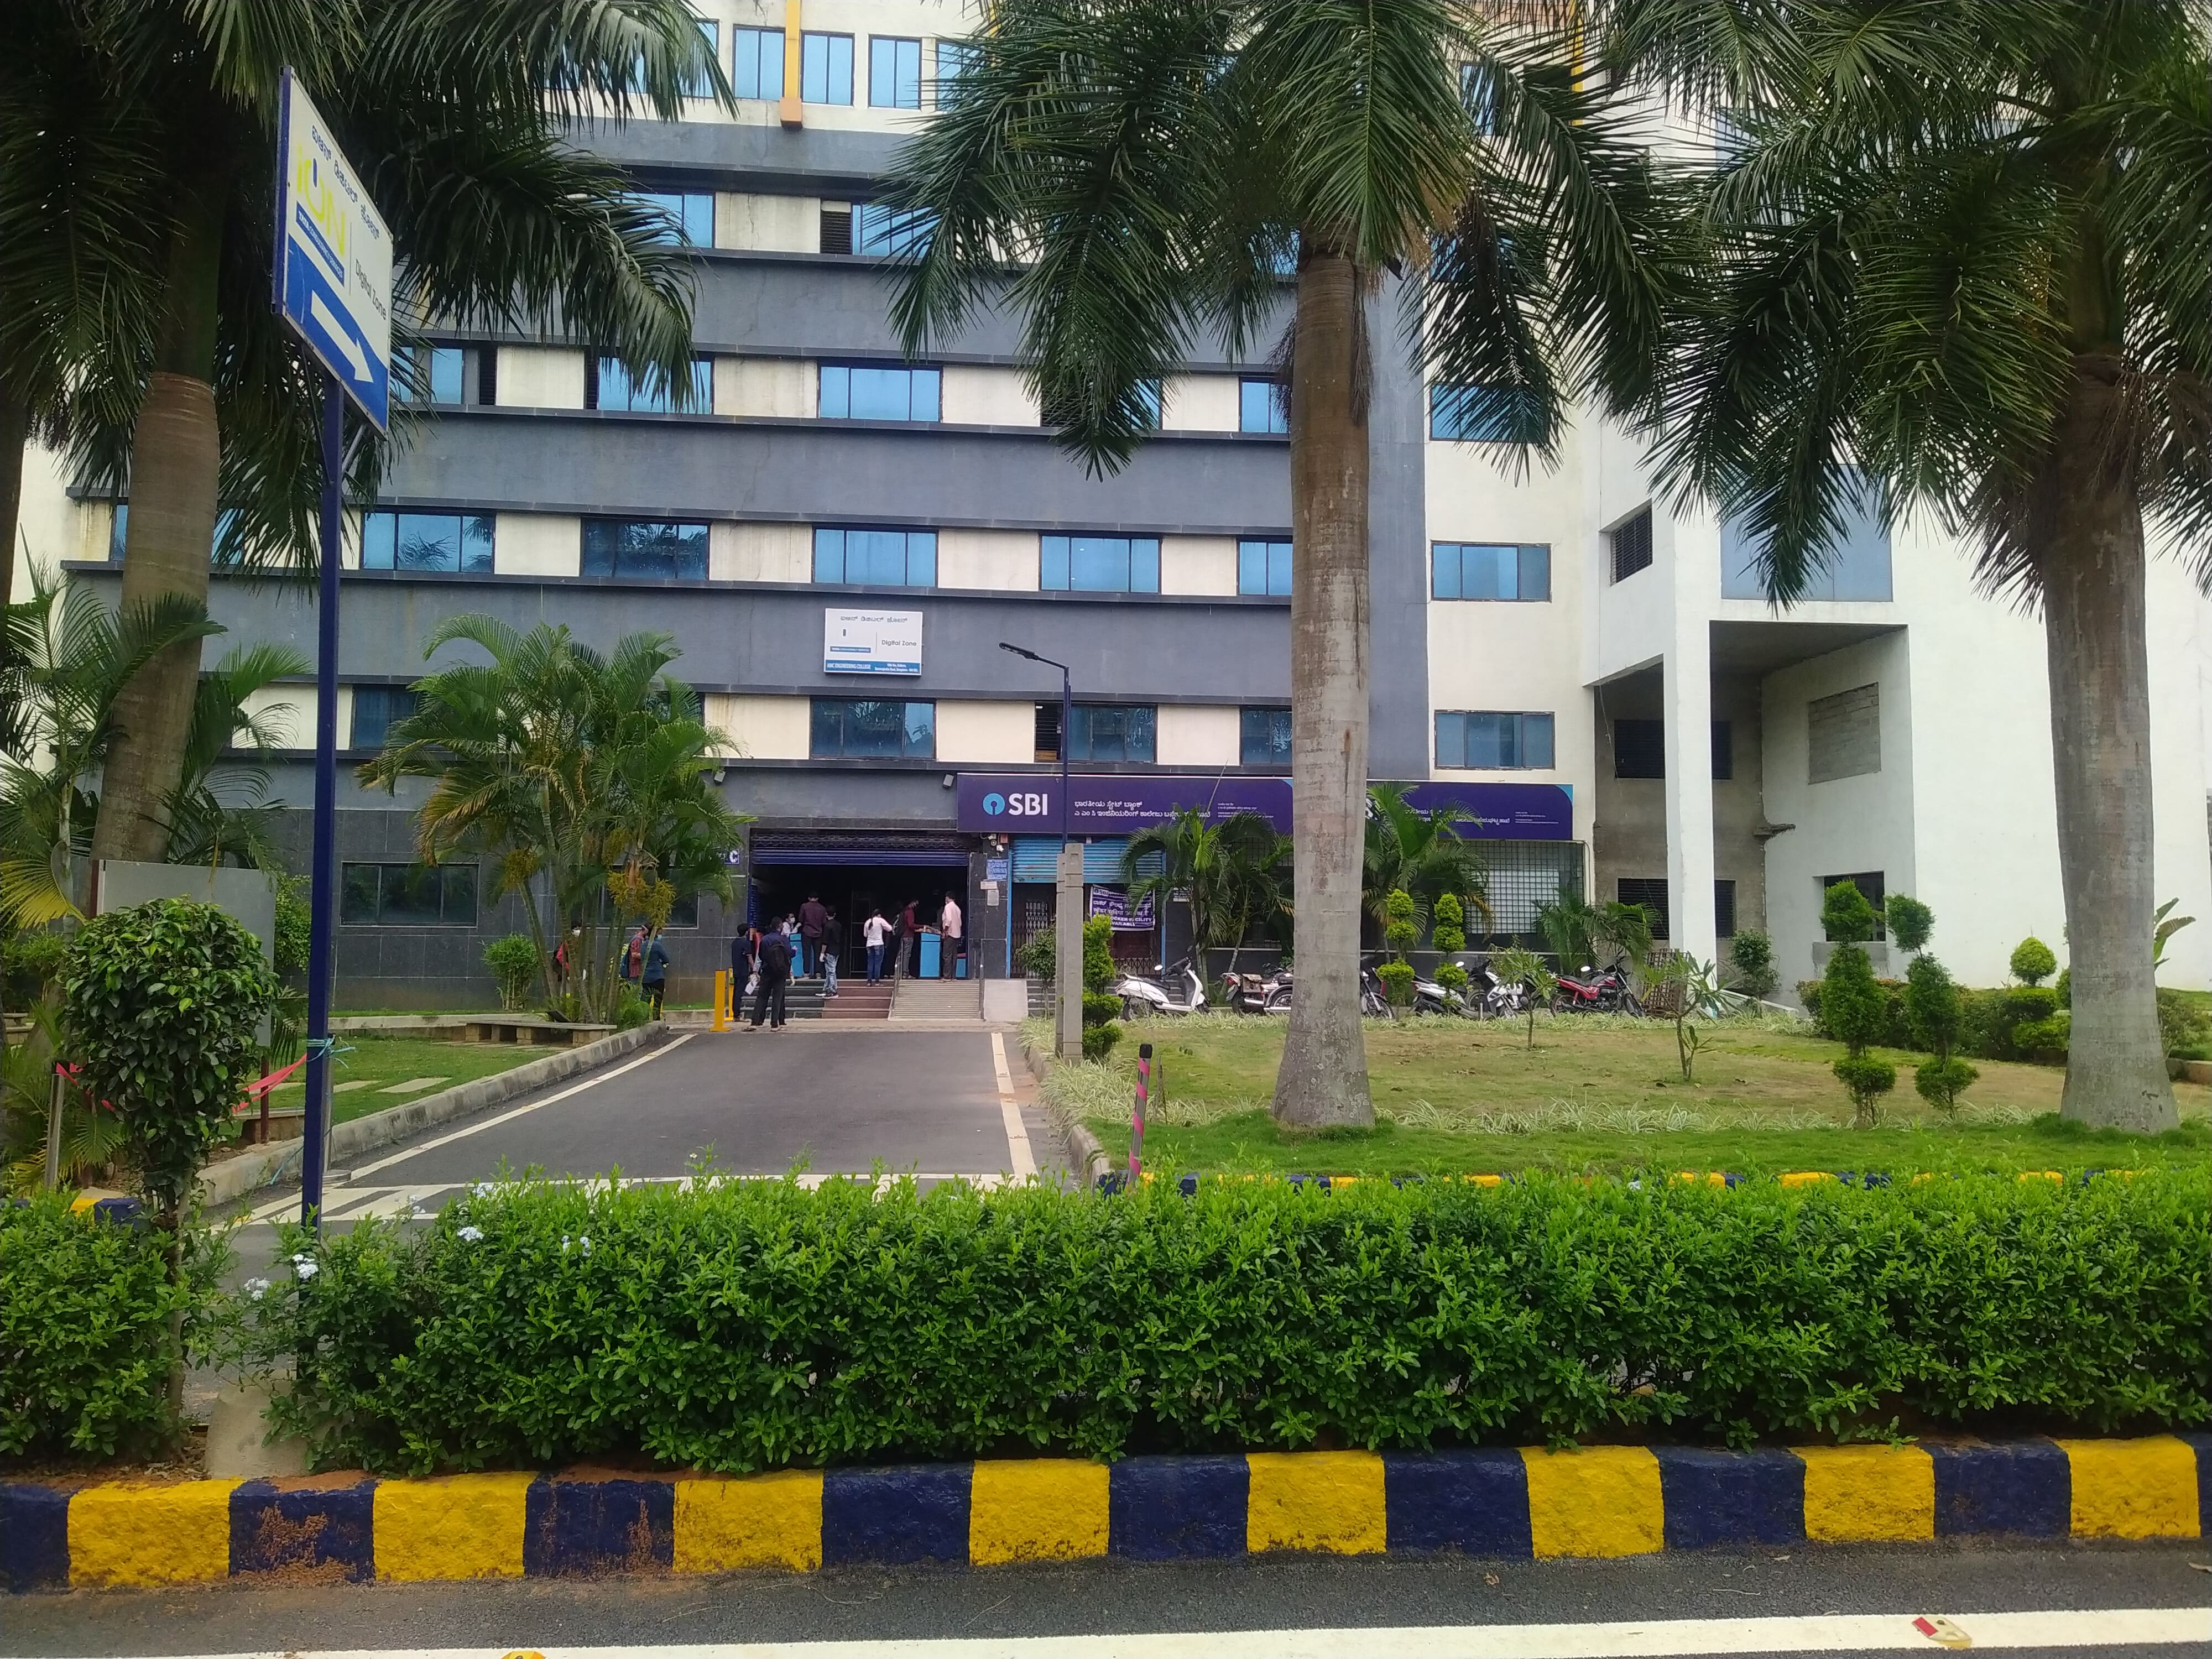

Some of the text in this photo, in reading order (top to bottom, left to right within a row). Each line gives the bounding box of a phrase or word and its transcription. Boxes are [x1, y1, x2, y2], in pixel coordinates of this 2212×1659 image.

[298, 211, 310, 231] TATA
[356, 259, 386, 321] Digital Zone
[1008, 793, 1048, 816] SBI
[1124, 801, 1142, 810] ಬ್ಯಾಂಕ್
